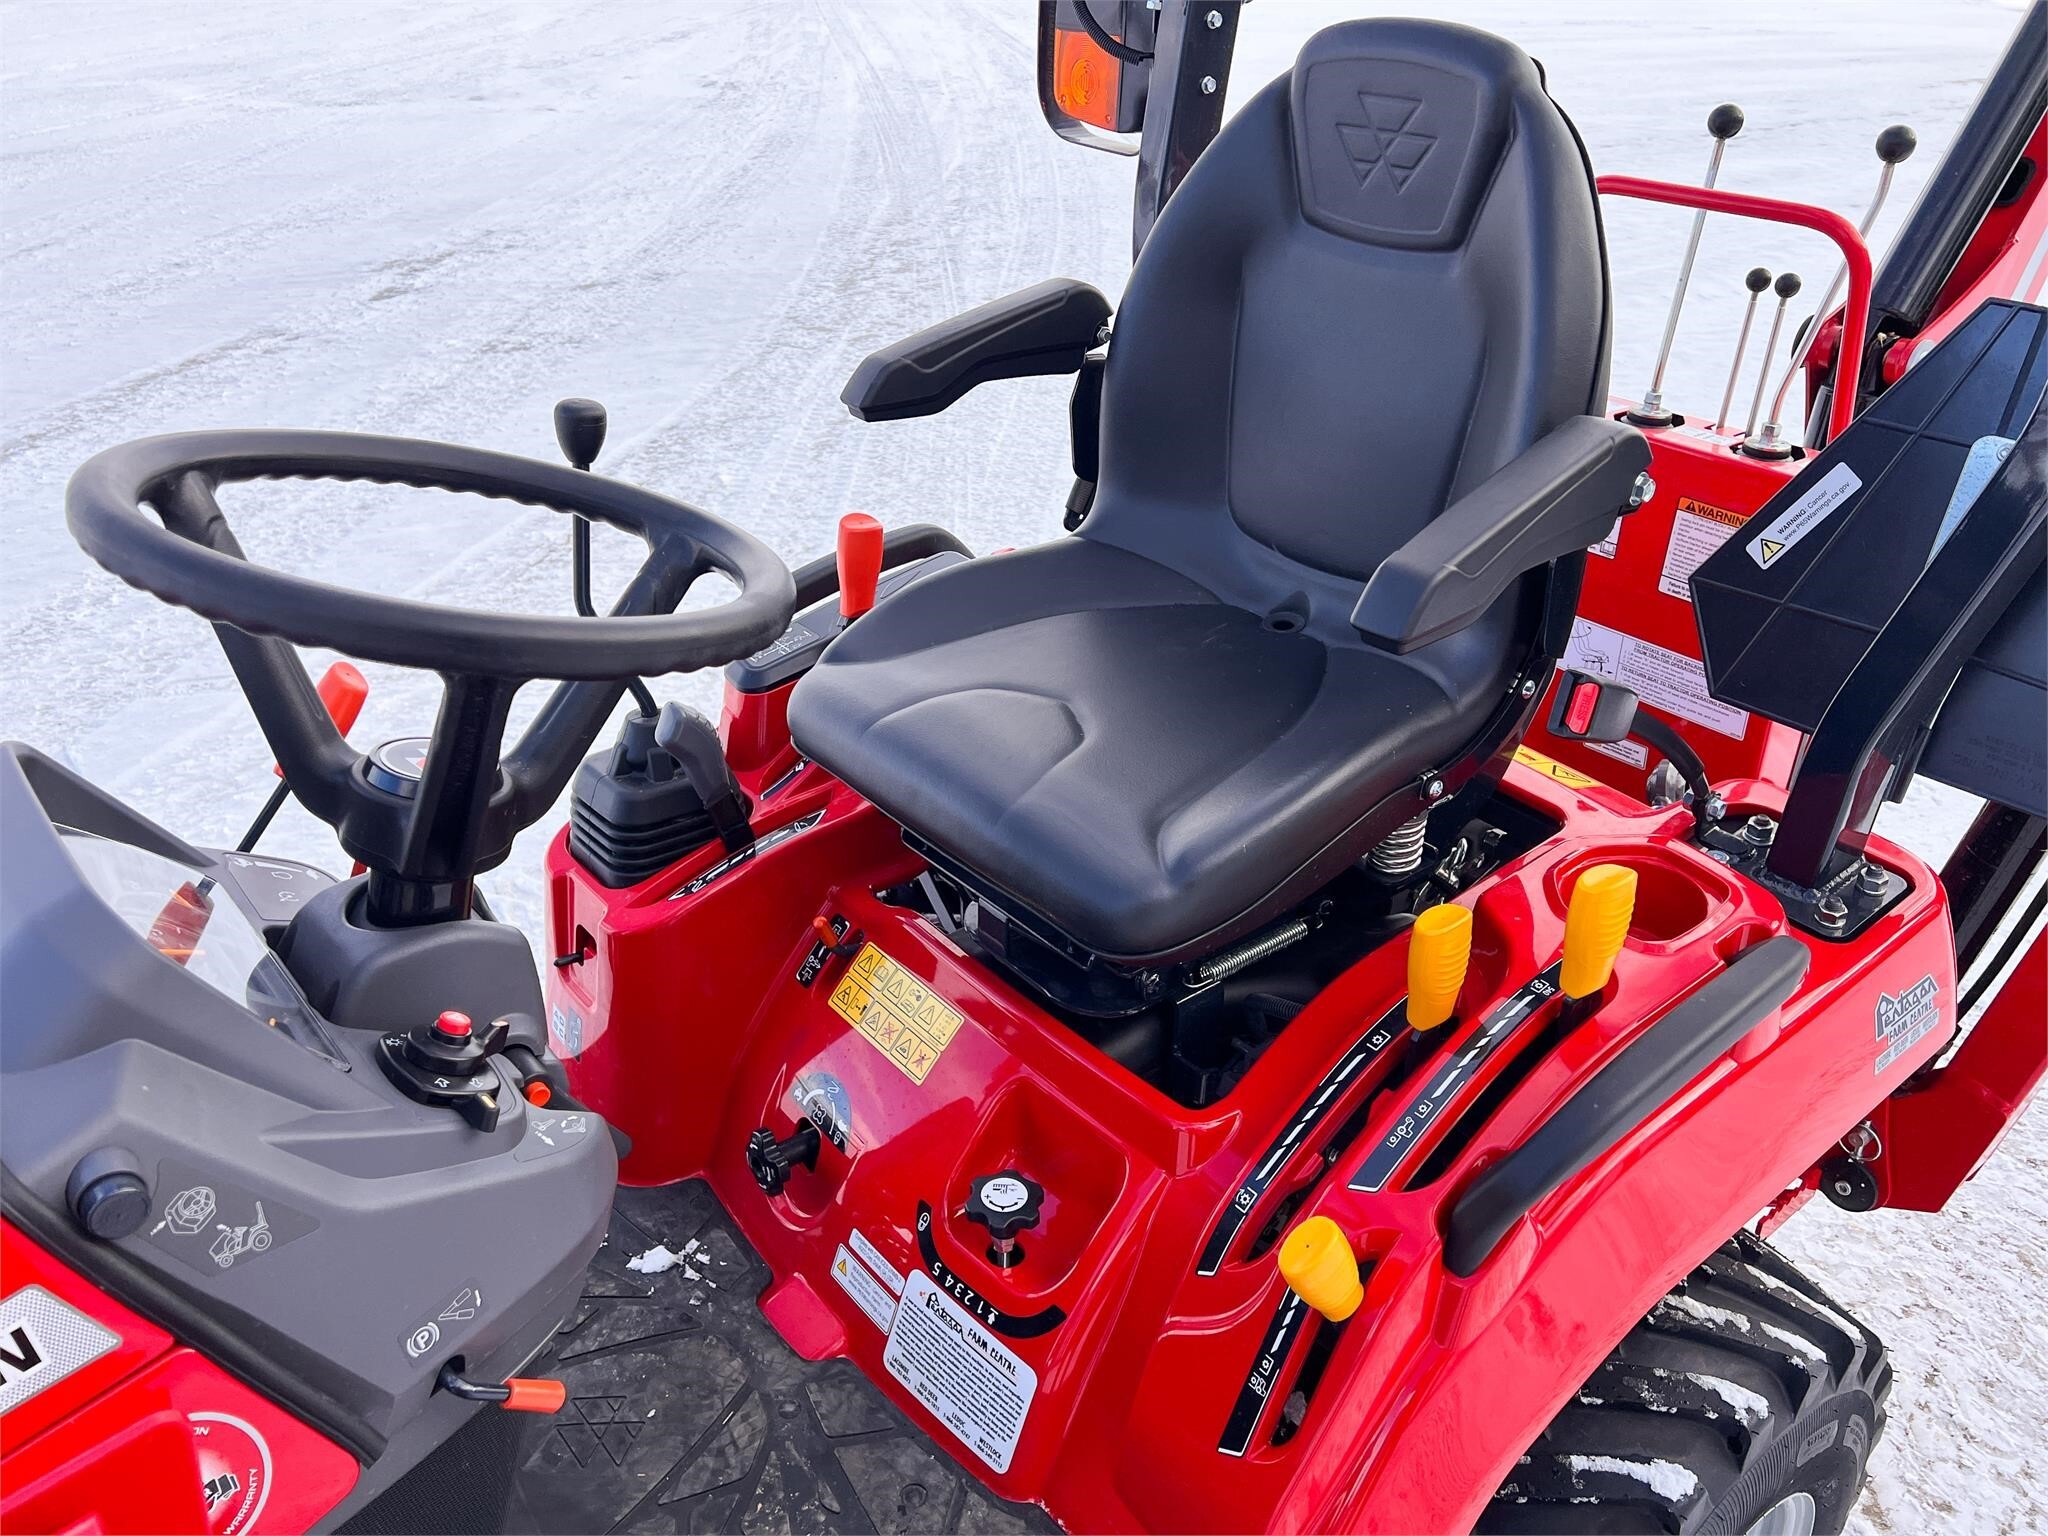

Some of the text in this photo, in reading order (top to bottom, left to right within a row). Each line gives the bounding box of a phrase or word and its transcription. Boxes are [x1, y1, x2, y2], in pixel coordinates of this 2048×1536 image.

[1806, 488, 1828, 509] Cancer
[1697, 504, 1750, 528] WARNIN
[1577, 694, 1592, 720] PRESS
[1889, 1019, 1908, 1042] FARM
[932, 1262, 984, 1315] 1 2 3 4 5
[967, 1327, 989, 1352] FARM
[223, 1468, 258, 1534] WARRANTY
